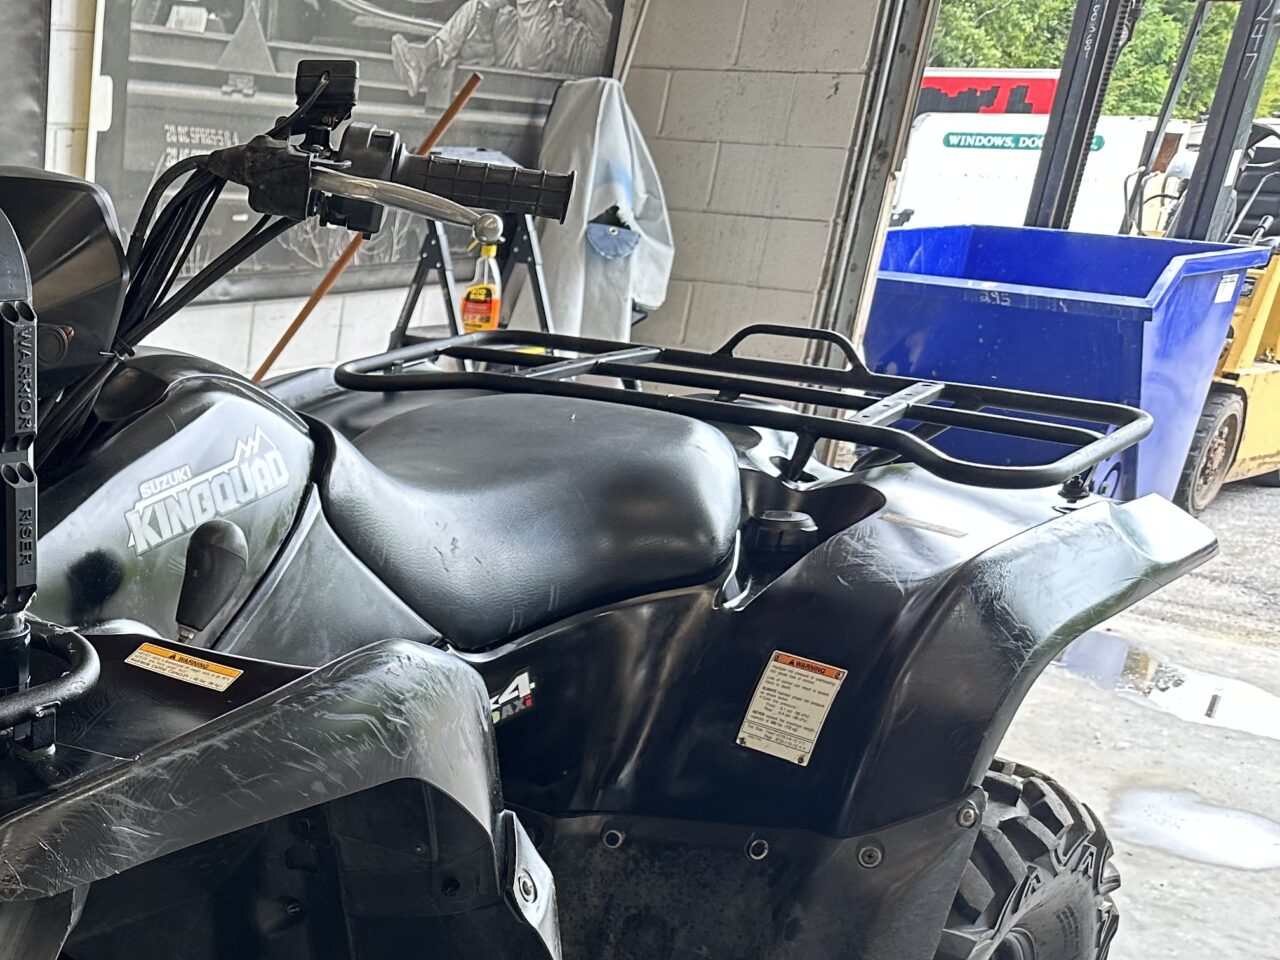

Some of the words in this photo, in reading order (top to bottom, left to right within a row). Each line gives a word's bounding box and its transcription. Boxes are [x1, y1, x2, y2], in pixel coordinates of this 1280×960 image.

[949, 134, 1015, 149] WINDOWS,
[17, 326, 33, 430] WARRIOR
[141, 465, 193, 498] SUZUKI
[126, 448, 290, 555] KINGQUAD
[19, 509, 32, 566] RISER
[177, 656, 209, 669] WARNING
[795, 660, 825, 674] WARNING
